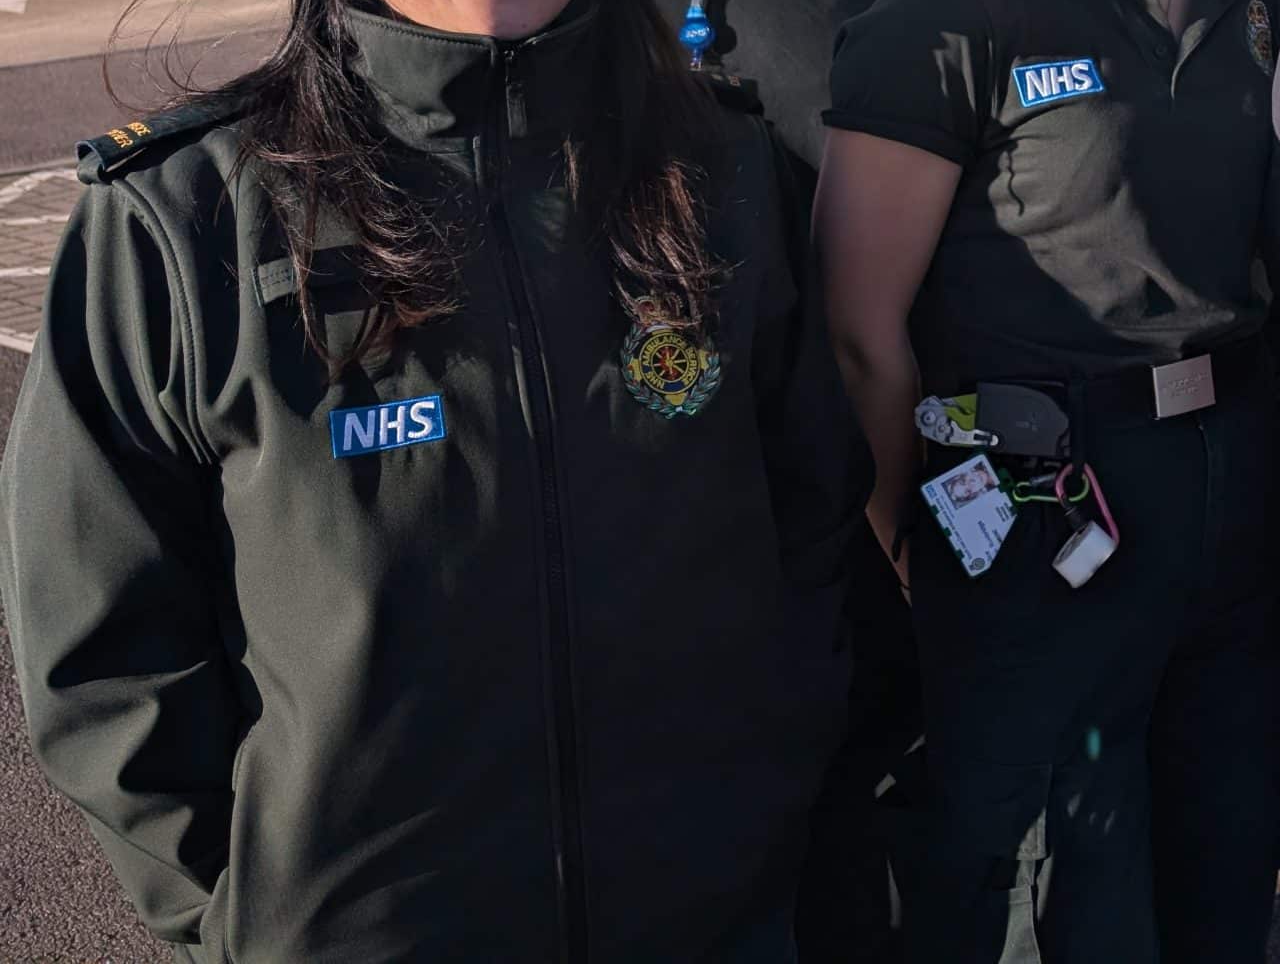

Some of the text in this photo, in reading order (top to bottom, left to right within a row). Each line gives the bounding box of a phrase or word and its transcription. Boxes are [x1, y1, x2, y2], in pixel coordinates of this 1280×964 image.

[1025, 63, 1093, 100] NHS
[645, 371, 665, 390] NHS
[342, 401, 436, 451] NHS
